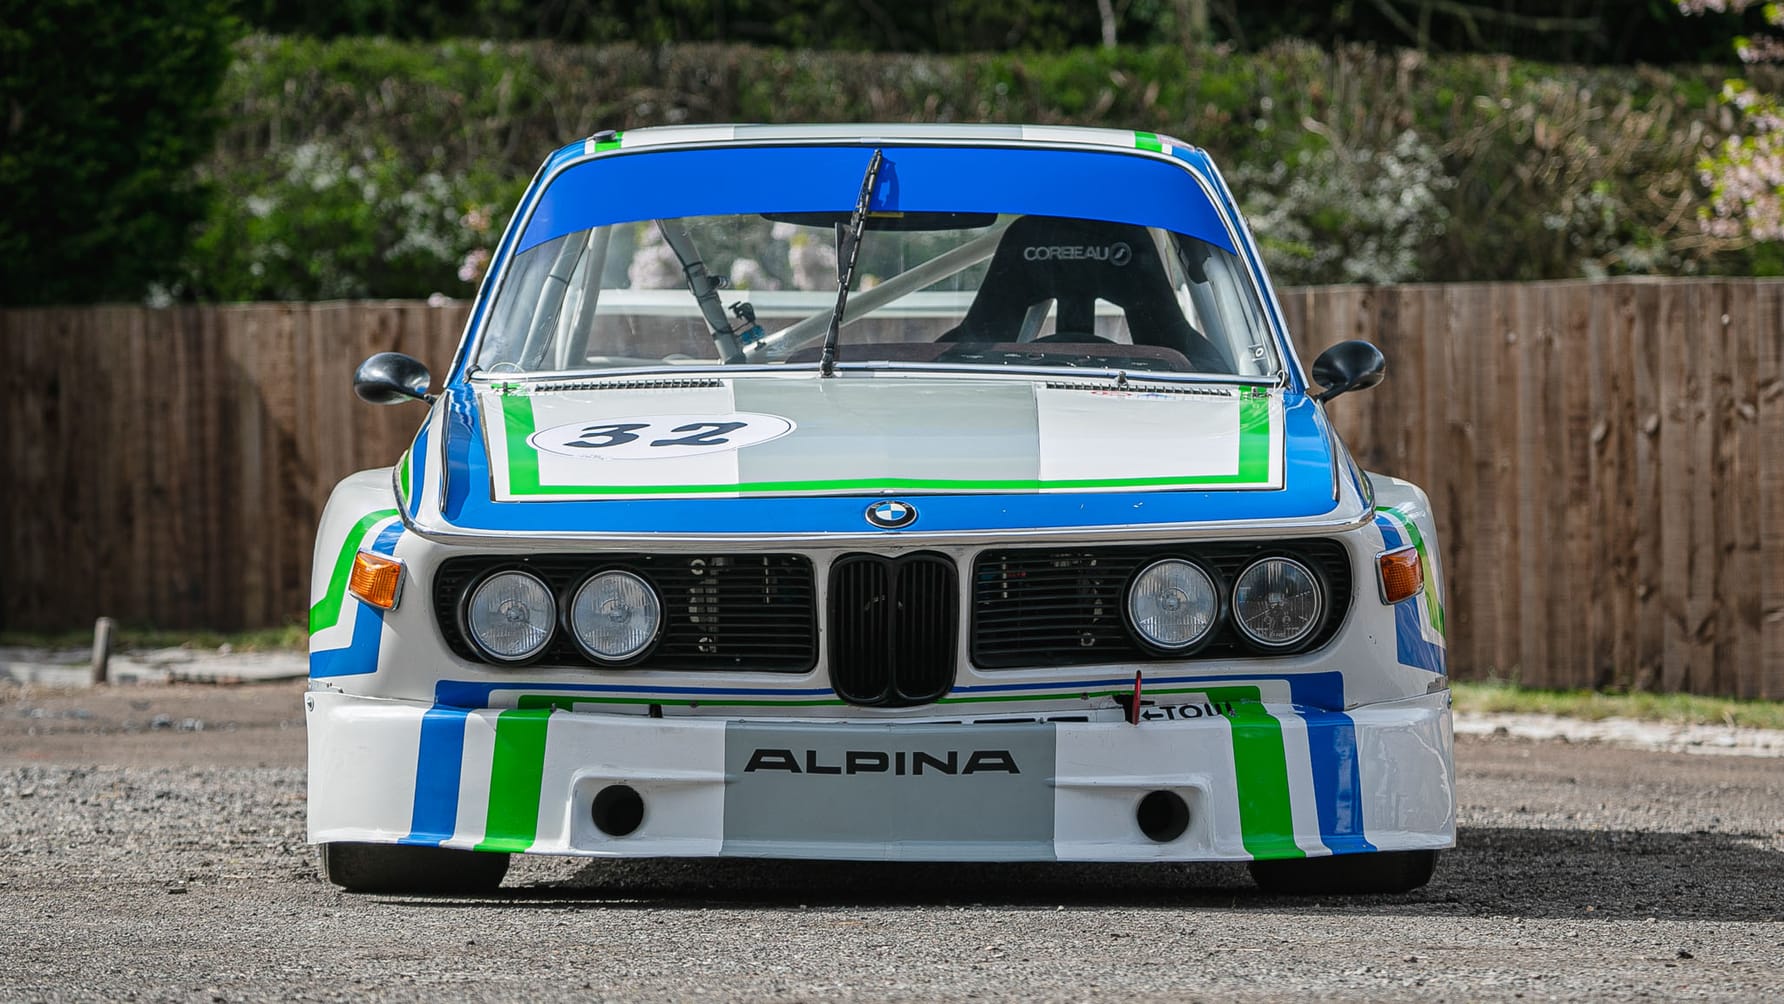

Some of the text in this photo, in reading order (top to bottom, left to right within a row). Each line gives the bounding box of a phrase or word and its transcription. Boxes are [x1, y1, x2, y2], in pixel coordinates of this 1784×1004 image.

[1023, 246, 1109, 261] CORBEAU
[562, 421, 748, 448] 32
[743, 748, 1021, 776] ALPINA
